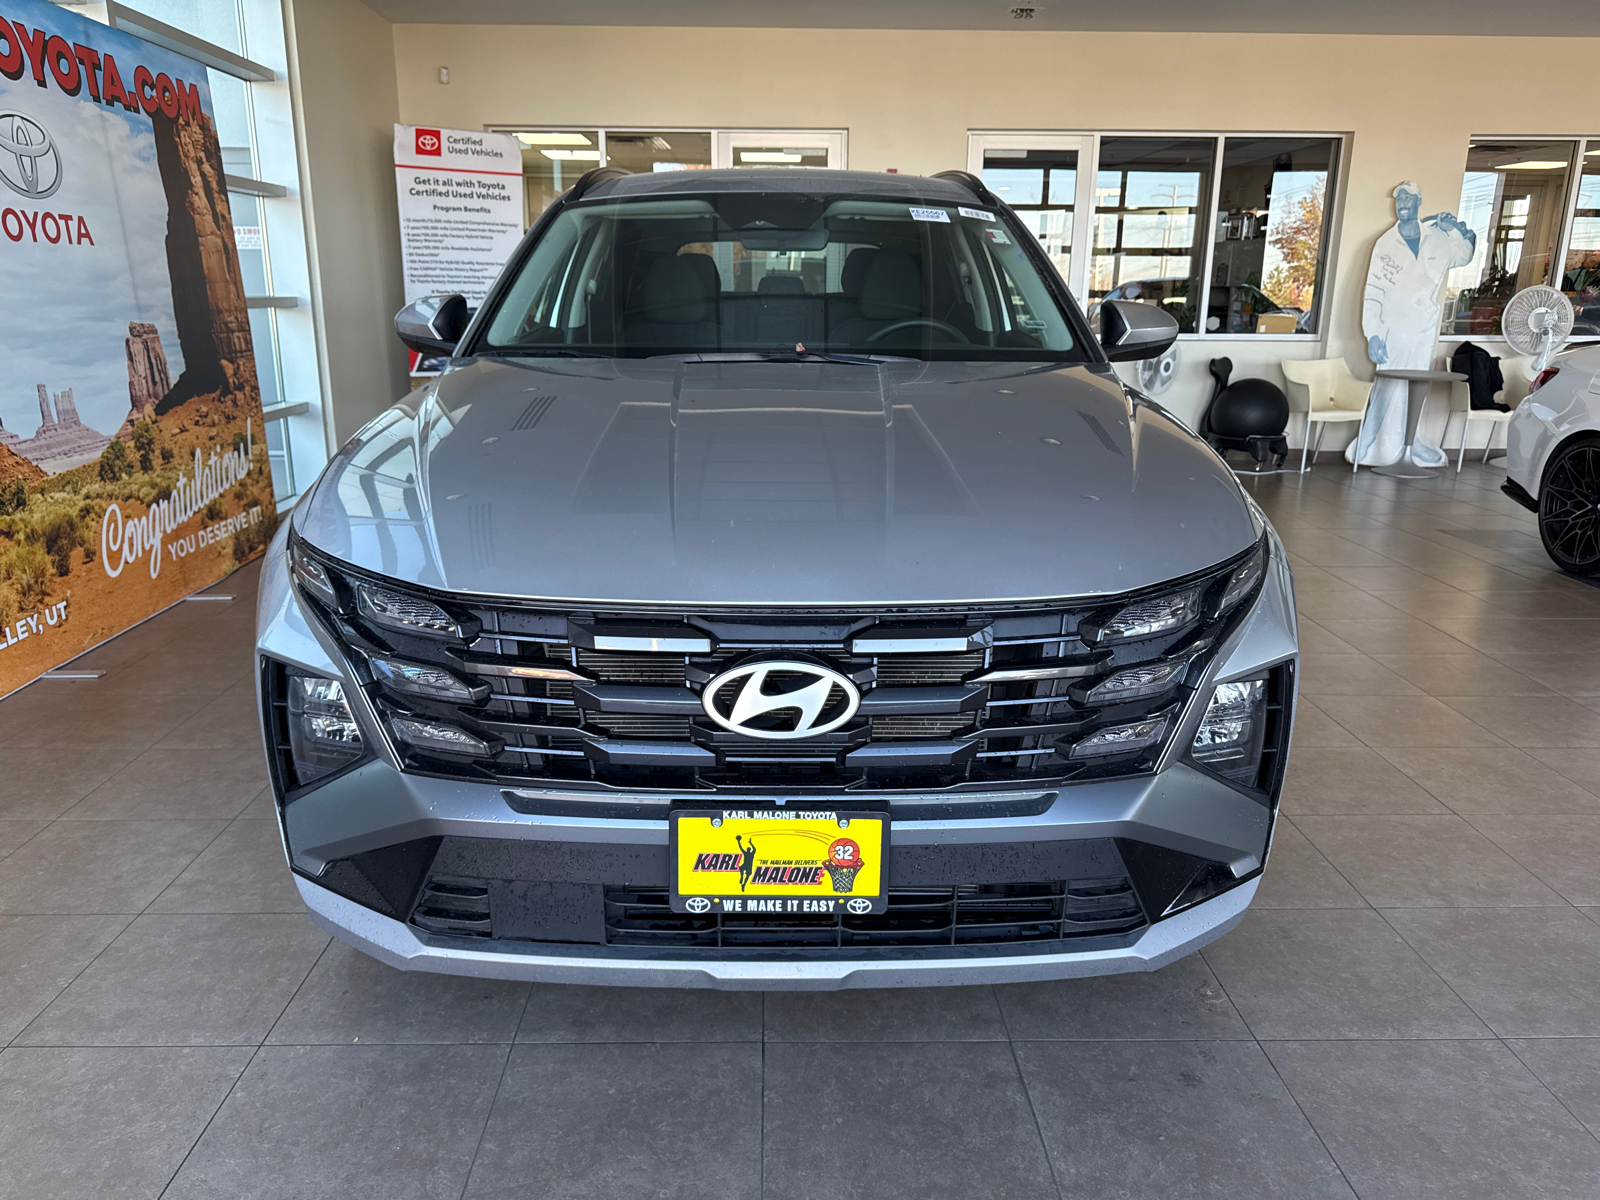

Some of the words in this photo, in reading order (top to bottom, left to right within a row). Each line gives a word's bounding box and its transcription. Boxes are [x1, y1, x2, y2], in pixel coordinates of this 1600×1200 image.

[447, 136, 483, 146] Certified
[448, 146, 468, 155] Used
[470, 147, 503, 158] Vehicles
[414, 176, 431, 186] Get
[433, 177, 440, 186] it
[442, 178, 454, 187] all
[455, 179, 475, 188] with
[477, 181, 506, 191] Toyota
[409, 188, 449, 198] Certified
[451, 190, 474, 199] Used
[475, 191, 511, 201] Vehicles
[433, 204, 462, 214] Program
[464, 206, 491, 214] Benefits
[102, 417, 254, 579] Congratulations!
[168, 535, 196, 561] YOU
[198, 512, 248, 548] DESERVE
[249, 505, 262, 525] IT!
[45, 600, 67, 626] UT
[723, 811, 750, 820] KARL
[754, 811, 796, 820] MALONE
[798, 812, 837, 820] TOYOTA
[834, 846, 853, 860] 32
[692, 853, 742, 872] KARL
[750, 866, 824, 885] MALONE
[722, 900, 742, 912] WE
[747, 900, 782, 912] MAKE
[787, 900, 798, 912] IT
[803, 900, 835, 912] EASY
